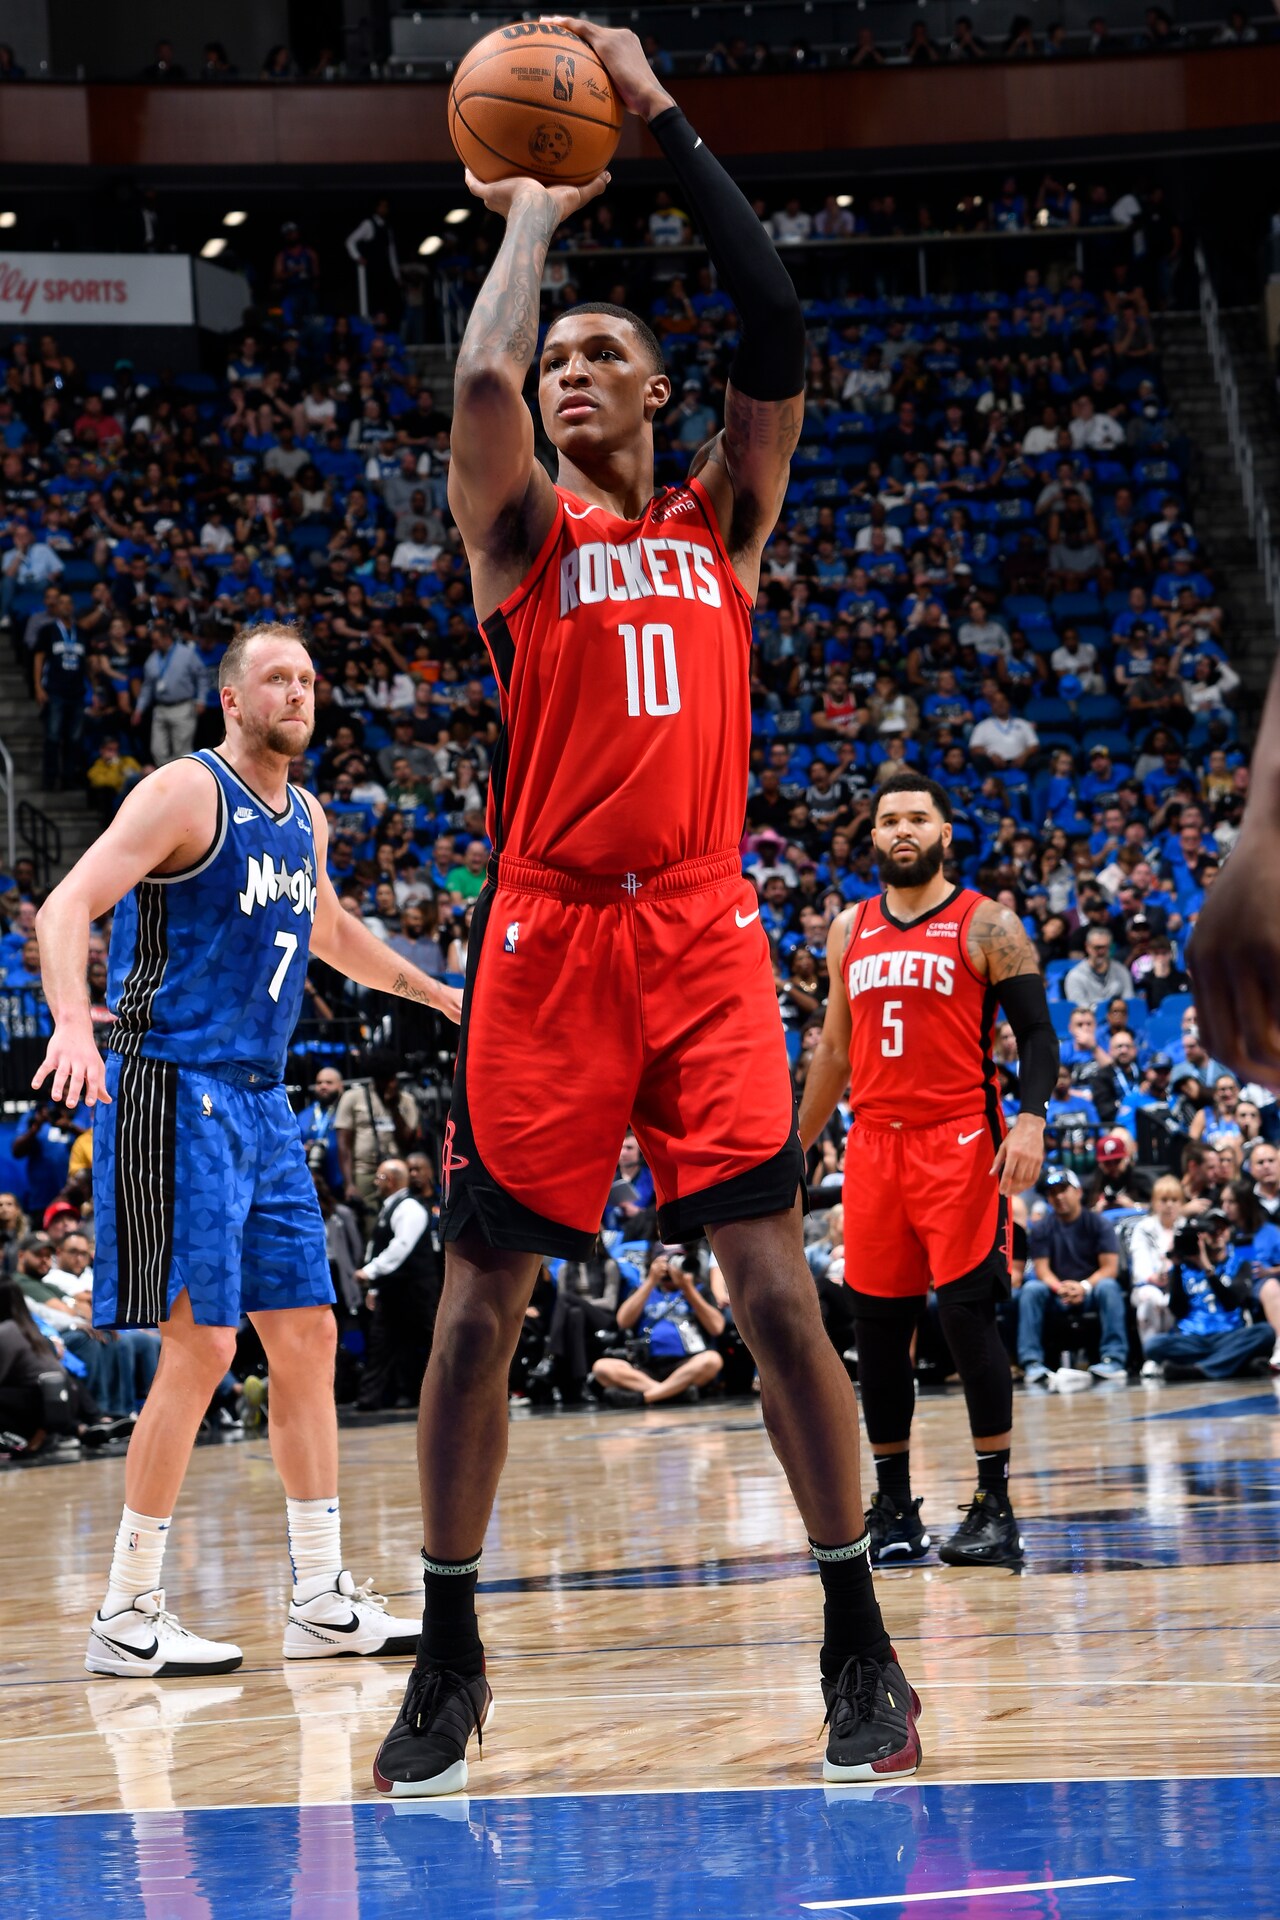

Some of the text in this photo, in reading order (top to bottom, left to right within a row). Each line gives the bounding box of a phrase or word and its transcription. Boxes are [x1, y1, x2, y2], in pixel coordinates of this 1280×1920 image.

[43, 279, 128, 304] SPORTS
[560, 537, 721, 619] ROCKETS
[618, 623, 681, 717] 10
[926, 928, 957, 938] karma
[929, 921, 959, 931] credit
[268, 930, 298, 1003] 7
[849, 951, 955, 1000] ROCKETS
[881, 1000, 903, 1058] 5
